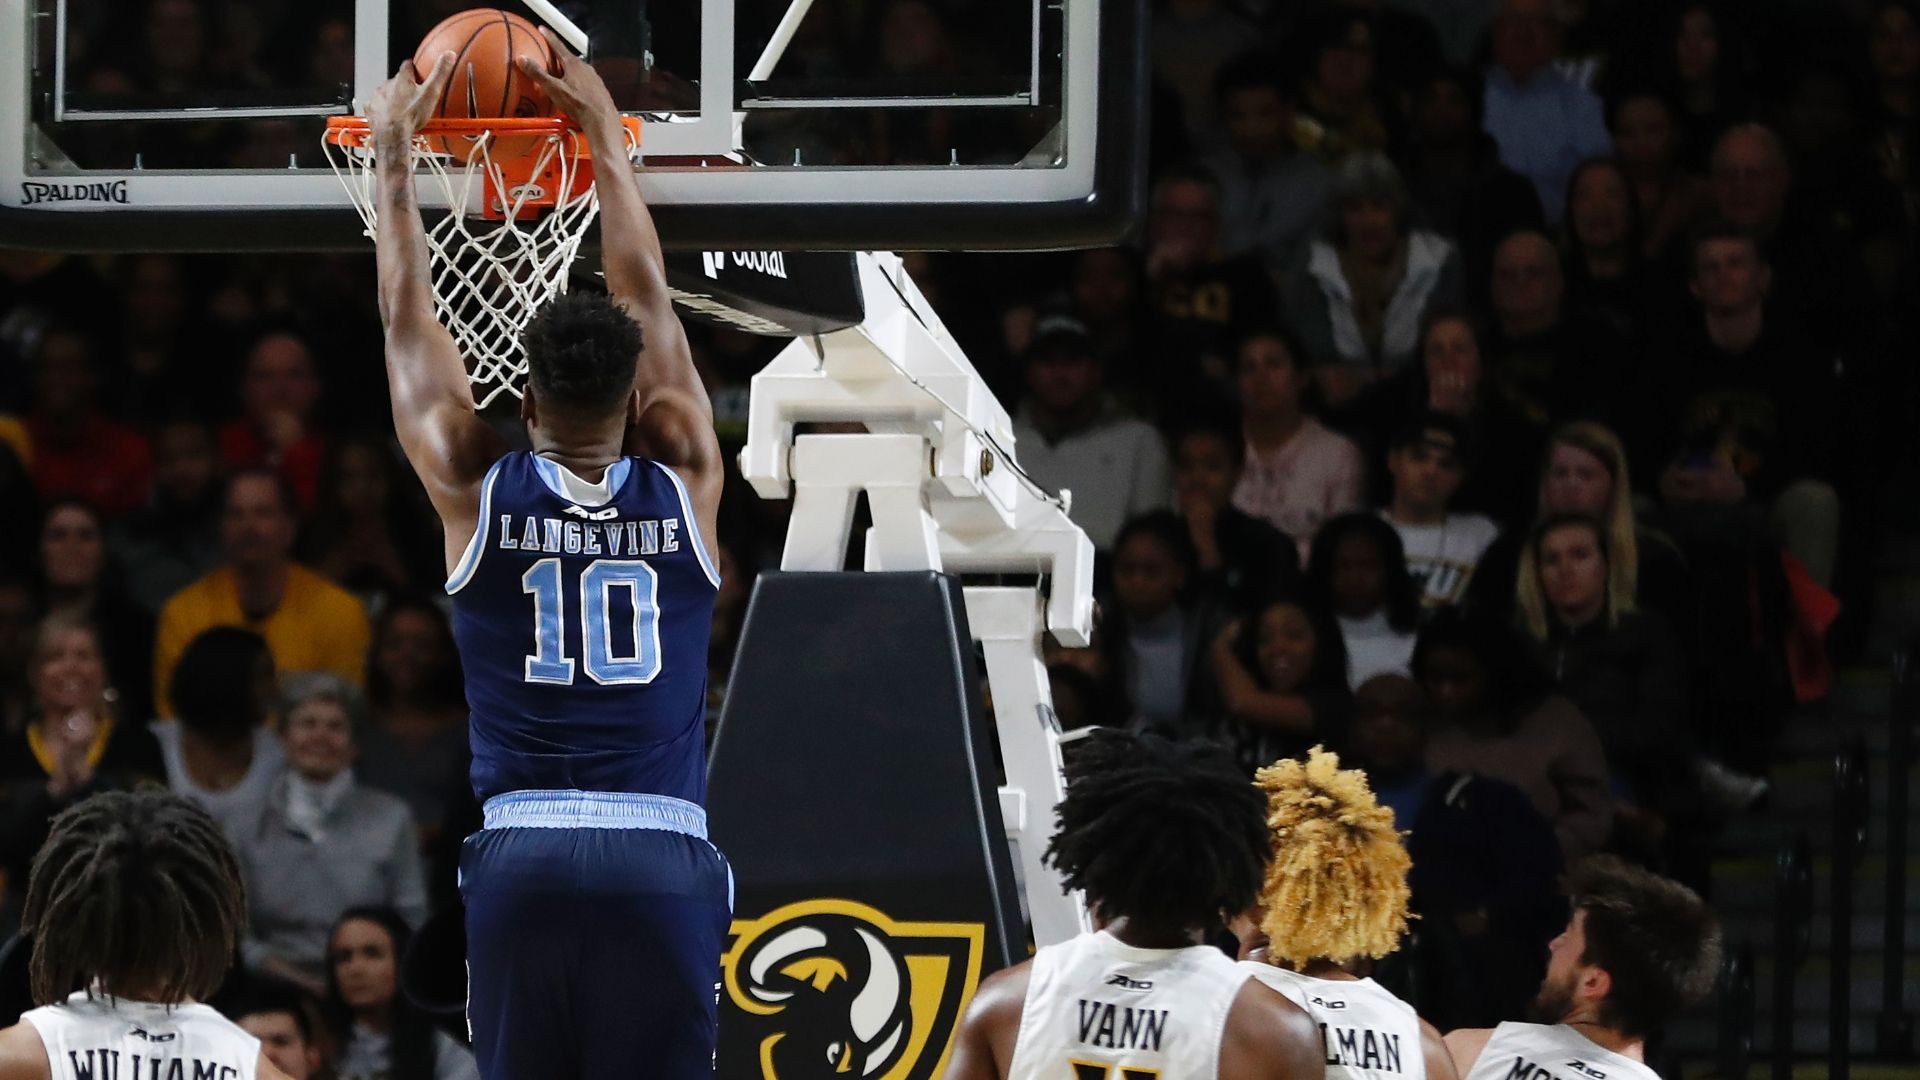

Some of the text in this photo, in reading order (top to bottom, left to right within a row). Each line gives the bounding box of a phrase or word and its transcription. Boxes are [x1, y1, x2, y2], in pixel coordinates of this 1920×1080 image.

[21, 180, 127, 205] SPALDING
[500, 514, 679, 555] LANGEVINE
[521, 557, 662, 686] 10
[1078, 999, 1169, 1052] VANN
